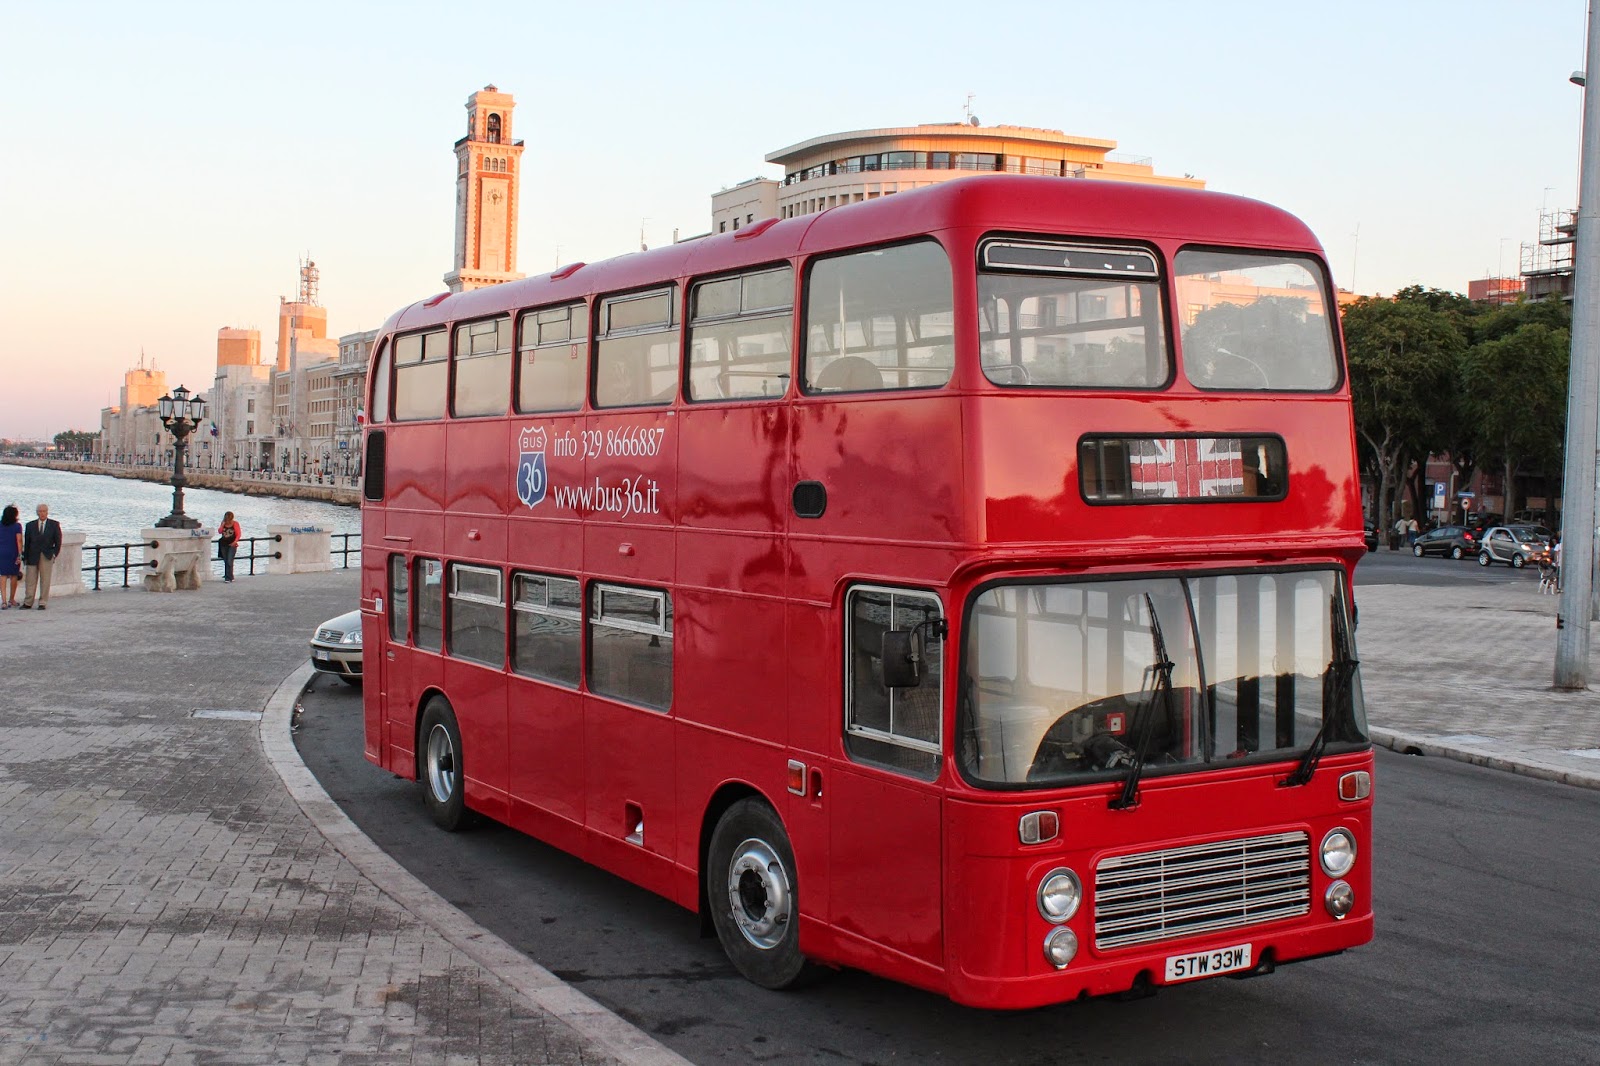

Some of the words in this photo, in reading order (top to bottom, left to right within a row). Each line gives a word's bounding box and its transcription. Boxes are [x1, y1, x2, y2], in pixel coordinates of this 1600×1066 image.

[522, 436, 543, 449] BUS
[553, 430, 577, 457] info
[580, 430, 603, 461] 329
[606, 425, 665, 457] 8666887
[521, 452, 542, 503] 36
[1437, 484, 1444, 495] P
[553, 474, 660, 519] www.bus36.it
